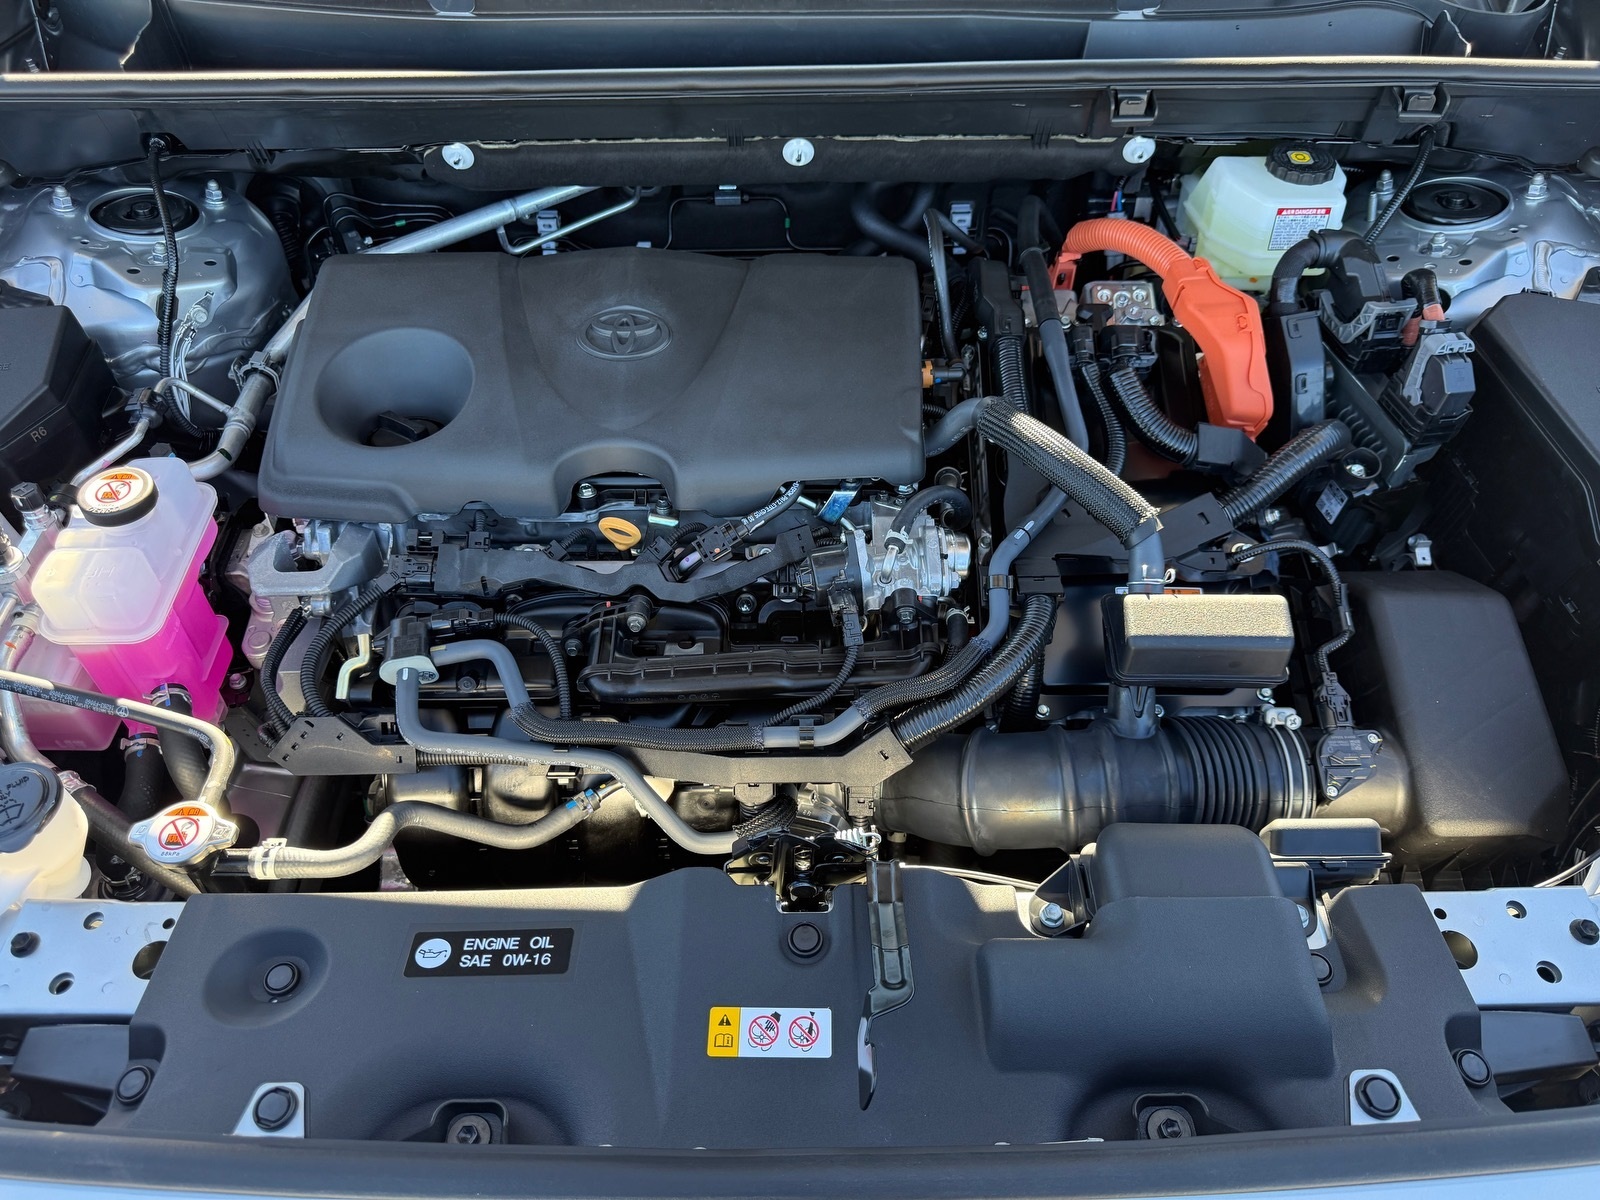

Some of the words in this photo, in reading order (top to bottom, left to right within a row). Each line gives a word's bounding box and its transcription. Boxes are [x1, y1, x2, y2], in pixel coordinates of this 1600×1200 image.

[30, 426, 47, 443] R6
[463, 937, 520, 951] ENGINE
[529, 936, 554, 949] OIL
[459, 954, 492, 968] SAE
[502, 953, 551, 967] 0W-16
